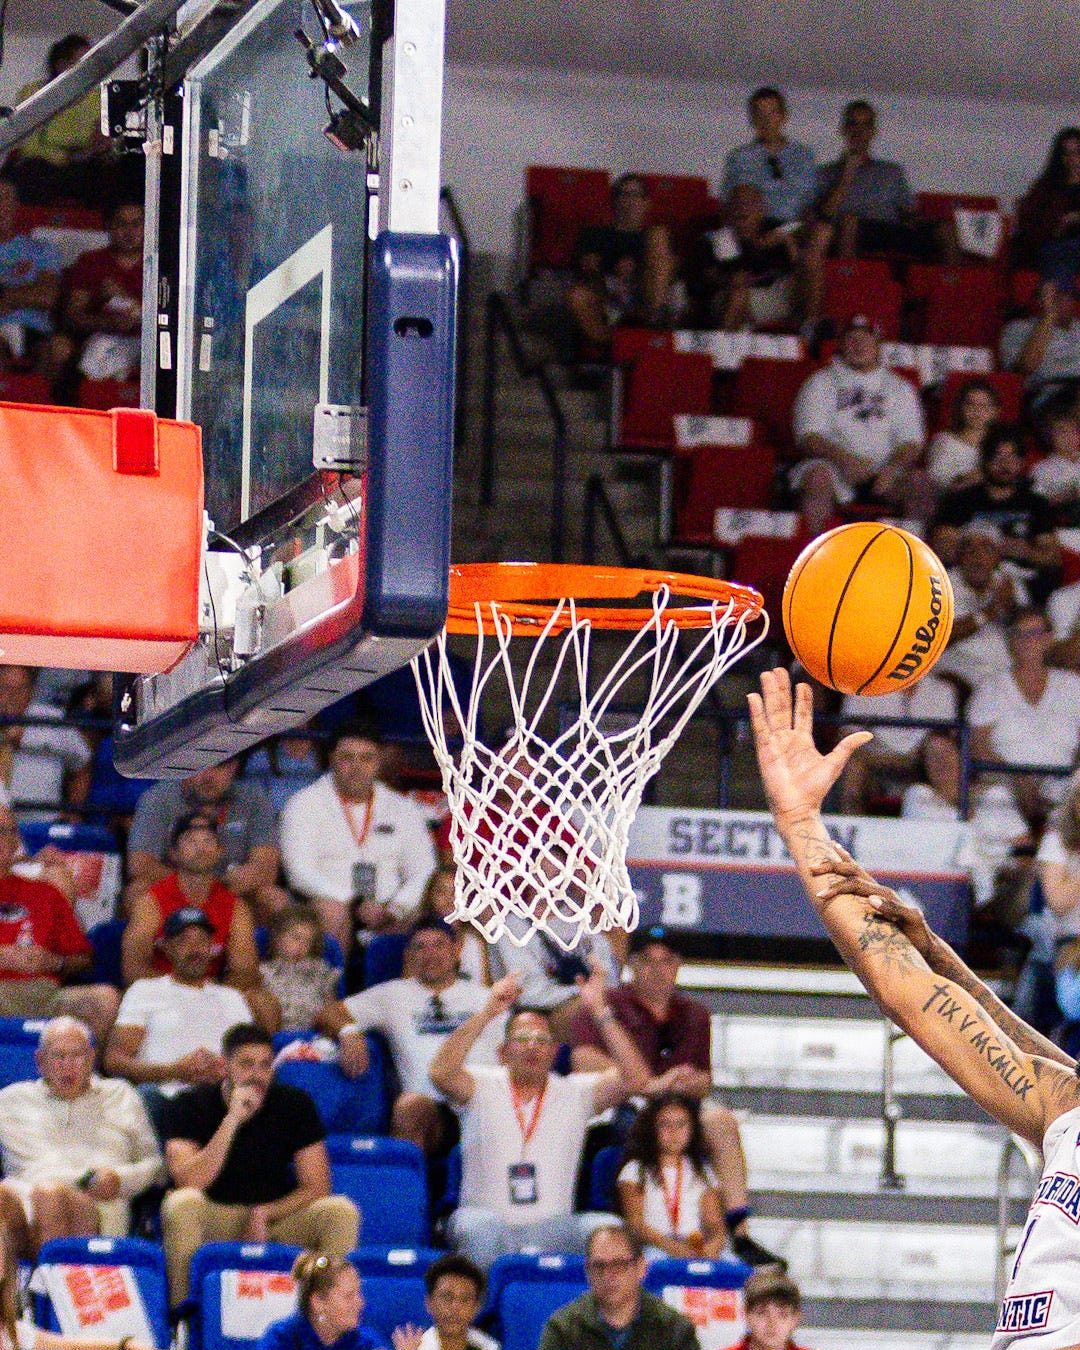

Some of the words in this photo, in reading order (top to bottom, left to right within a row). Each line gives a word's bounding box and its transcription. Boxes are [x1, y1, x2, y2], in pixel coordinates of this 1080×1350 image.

[886, 576, 943, 680] Wilson
[669, 817, 857, 859] SECTN
[660, 873, 702, 927] B
